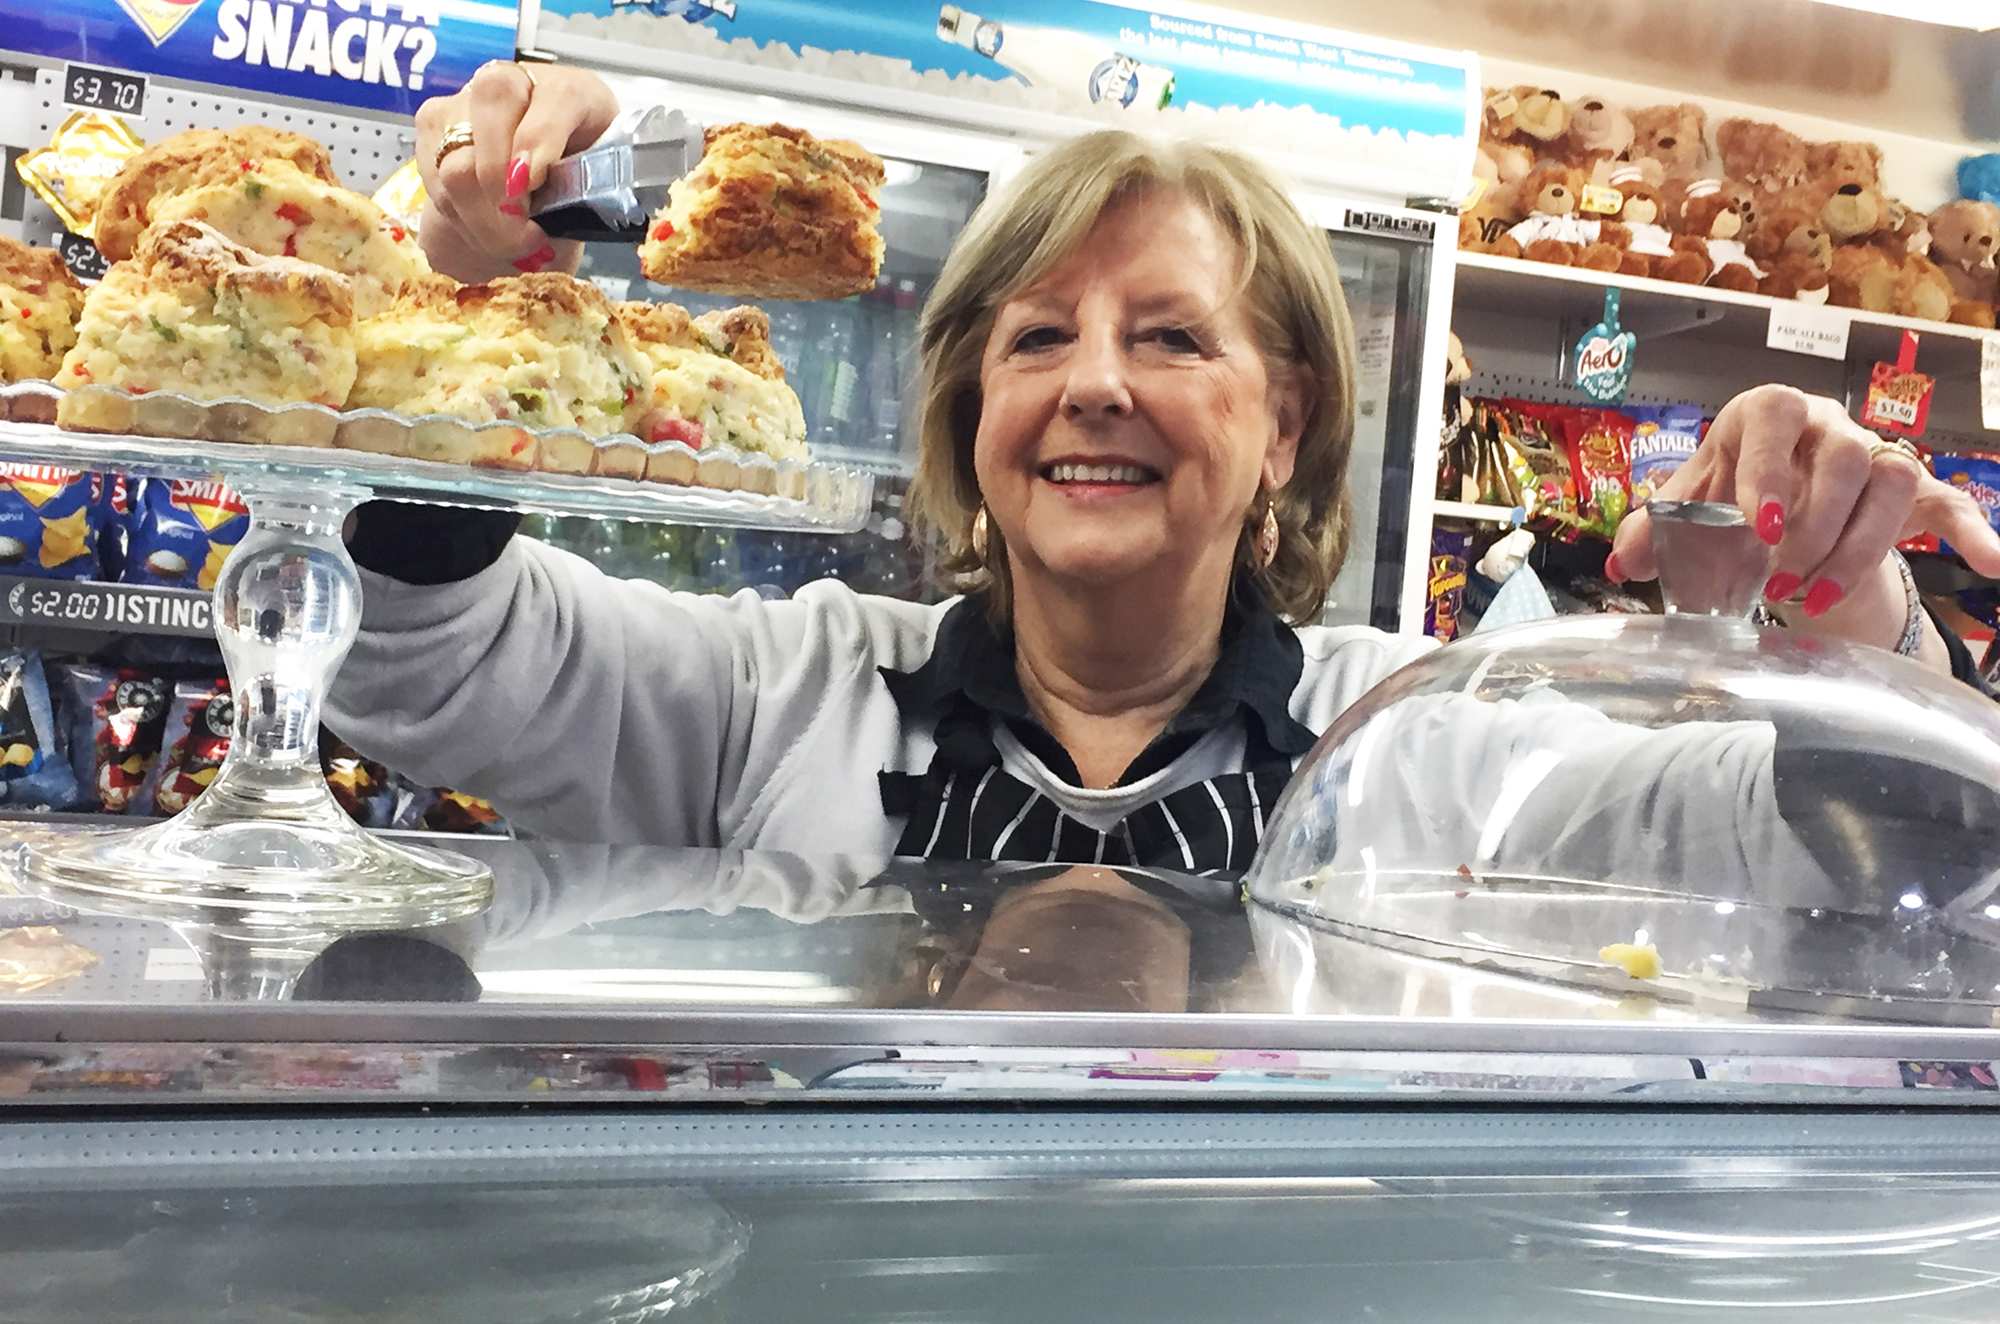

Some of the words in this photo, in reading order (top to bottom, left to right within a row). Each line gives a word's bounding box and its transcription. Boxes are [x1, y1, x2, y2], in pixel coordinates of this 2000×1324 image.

[213, 0, 437, 91] SNACK?
[73, 76, 138, 109] $3.70
[1630, 434, 1698, 460] FANTALES
[31, 592, 99, 619] $2.00
[104, 593, 215, 629] ISTINC
